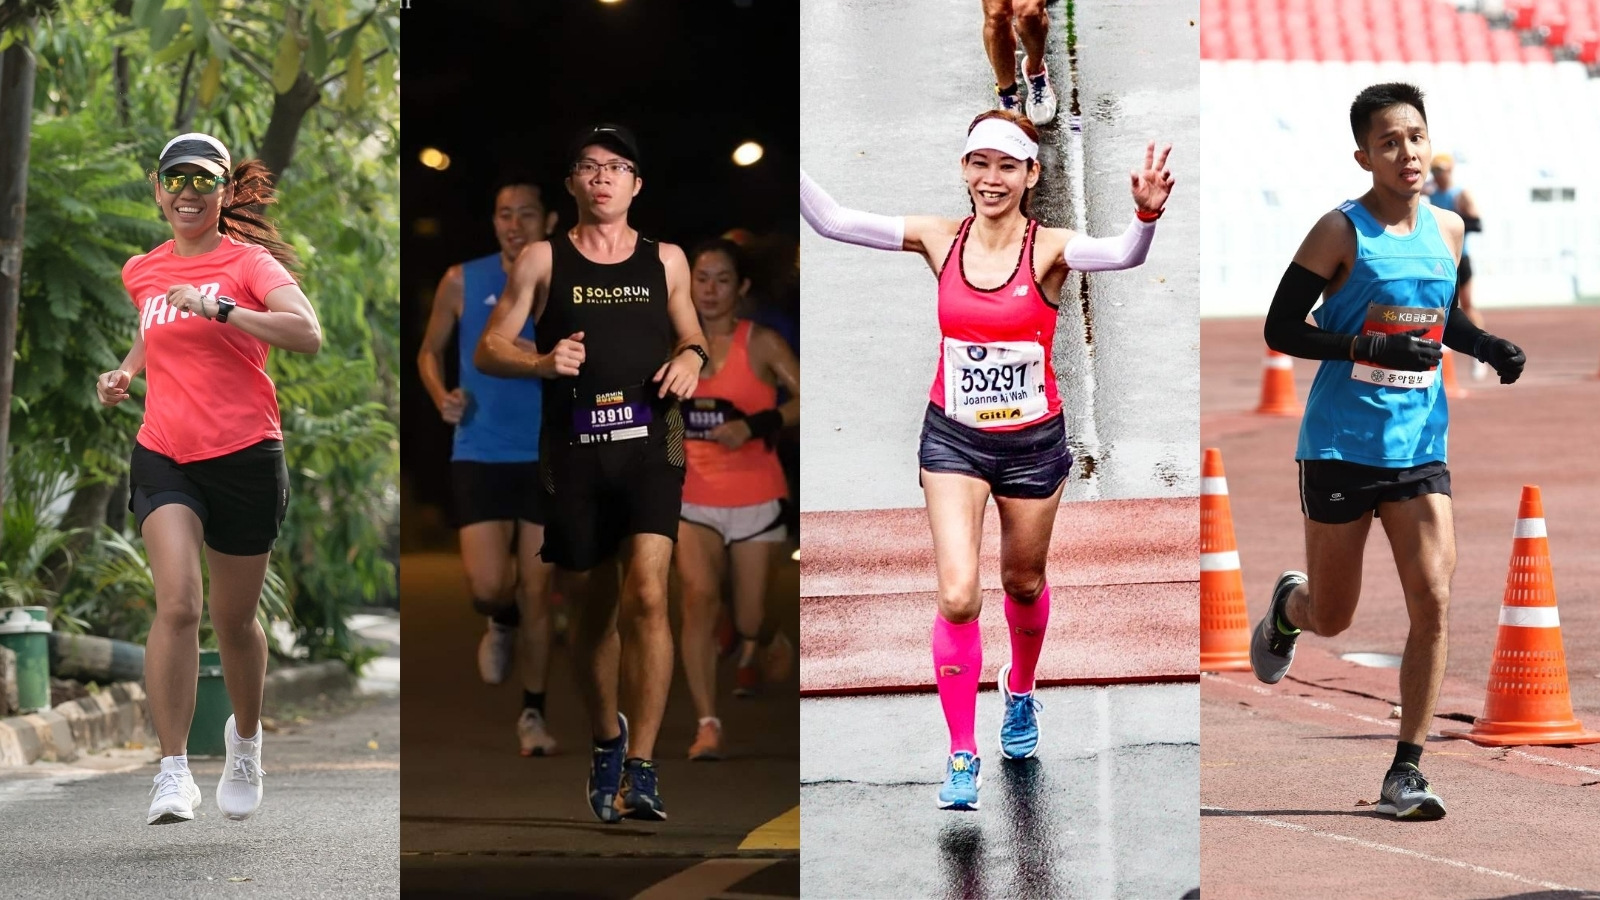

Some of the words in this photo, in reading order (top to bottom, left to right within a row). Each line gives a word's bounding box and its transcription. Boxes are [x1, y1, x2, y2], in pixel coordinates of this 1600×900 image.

[586, 286, 650, 298] SOLORUN
[963, 394, 998, 406] Joanne
[1000, 393, 1009, 403] Ai
[1009, 389, 1028, 401] Wah
[979, 411, 1007, 420] Giti
